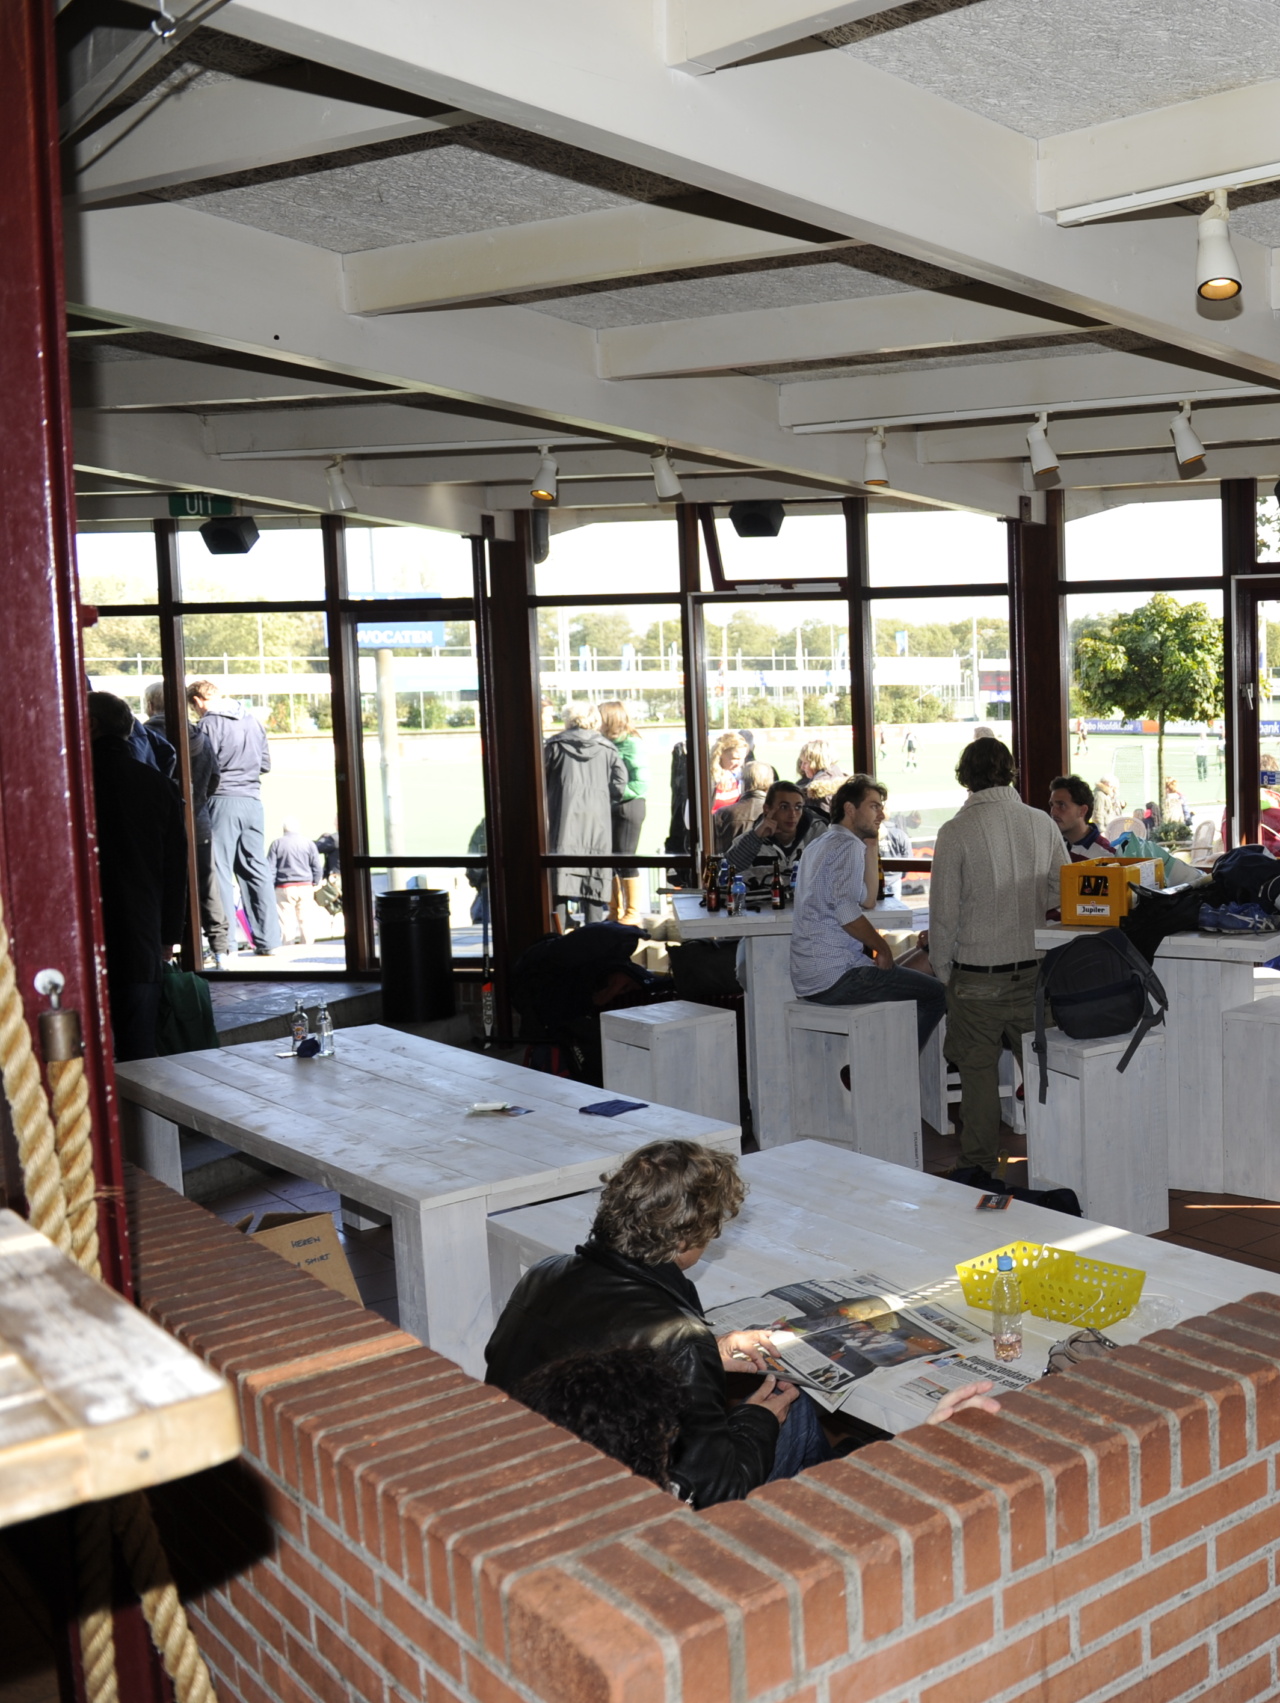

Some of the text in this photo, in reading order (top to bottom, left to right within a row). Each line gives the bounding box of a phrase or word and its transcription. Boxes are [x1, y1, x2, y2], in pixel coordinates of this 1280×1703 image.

[185, 494, 214, 514] UIT
[1260, 722, 1280, 734] bank
[1082, 906, 1106, 915] Jupiler
